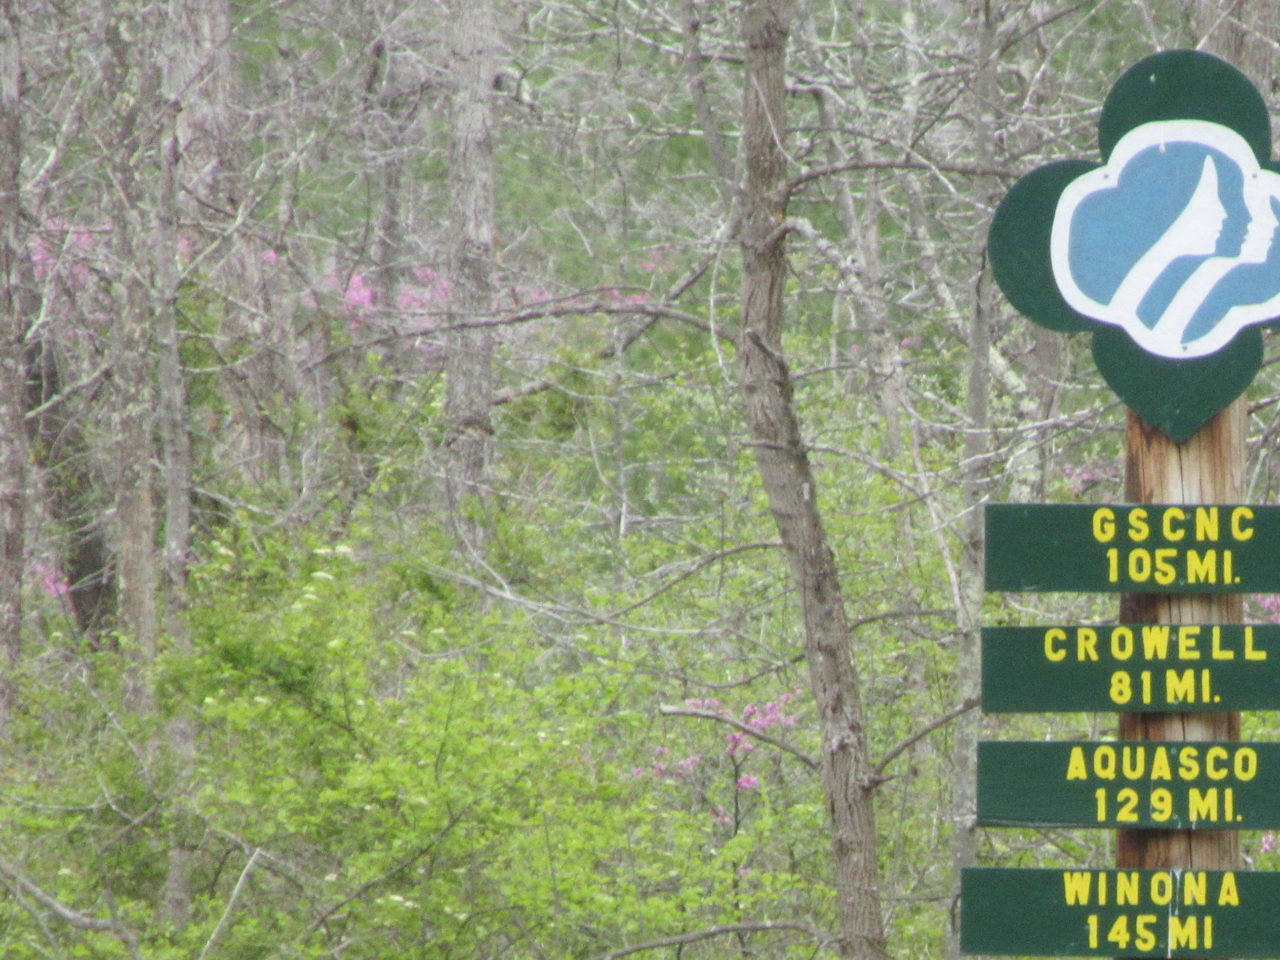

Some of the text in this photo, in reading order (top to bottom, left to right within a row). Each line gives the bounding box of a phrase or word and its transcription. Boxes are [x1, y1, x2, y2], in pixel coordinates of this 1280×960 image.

[1092, 506, 1254, 543] GSCNC
[1106, 548, 1241, 586] 105 MI.
[1044, 625, 1267, 662] CROWELL
[1109, 668, 1221, 705] 81 MI.
[1066, 744, 1258, 781] AQUASCO
[1095, 787, 1243, 822] 129 MI.
[1063, 871, 1240, 906] WINONA
[1087, 914, 1213, 952] 145 MI
